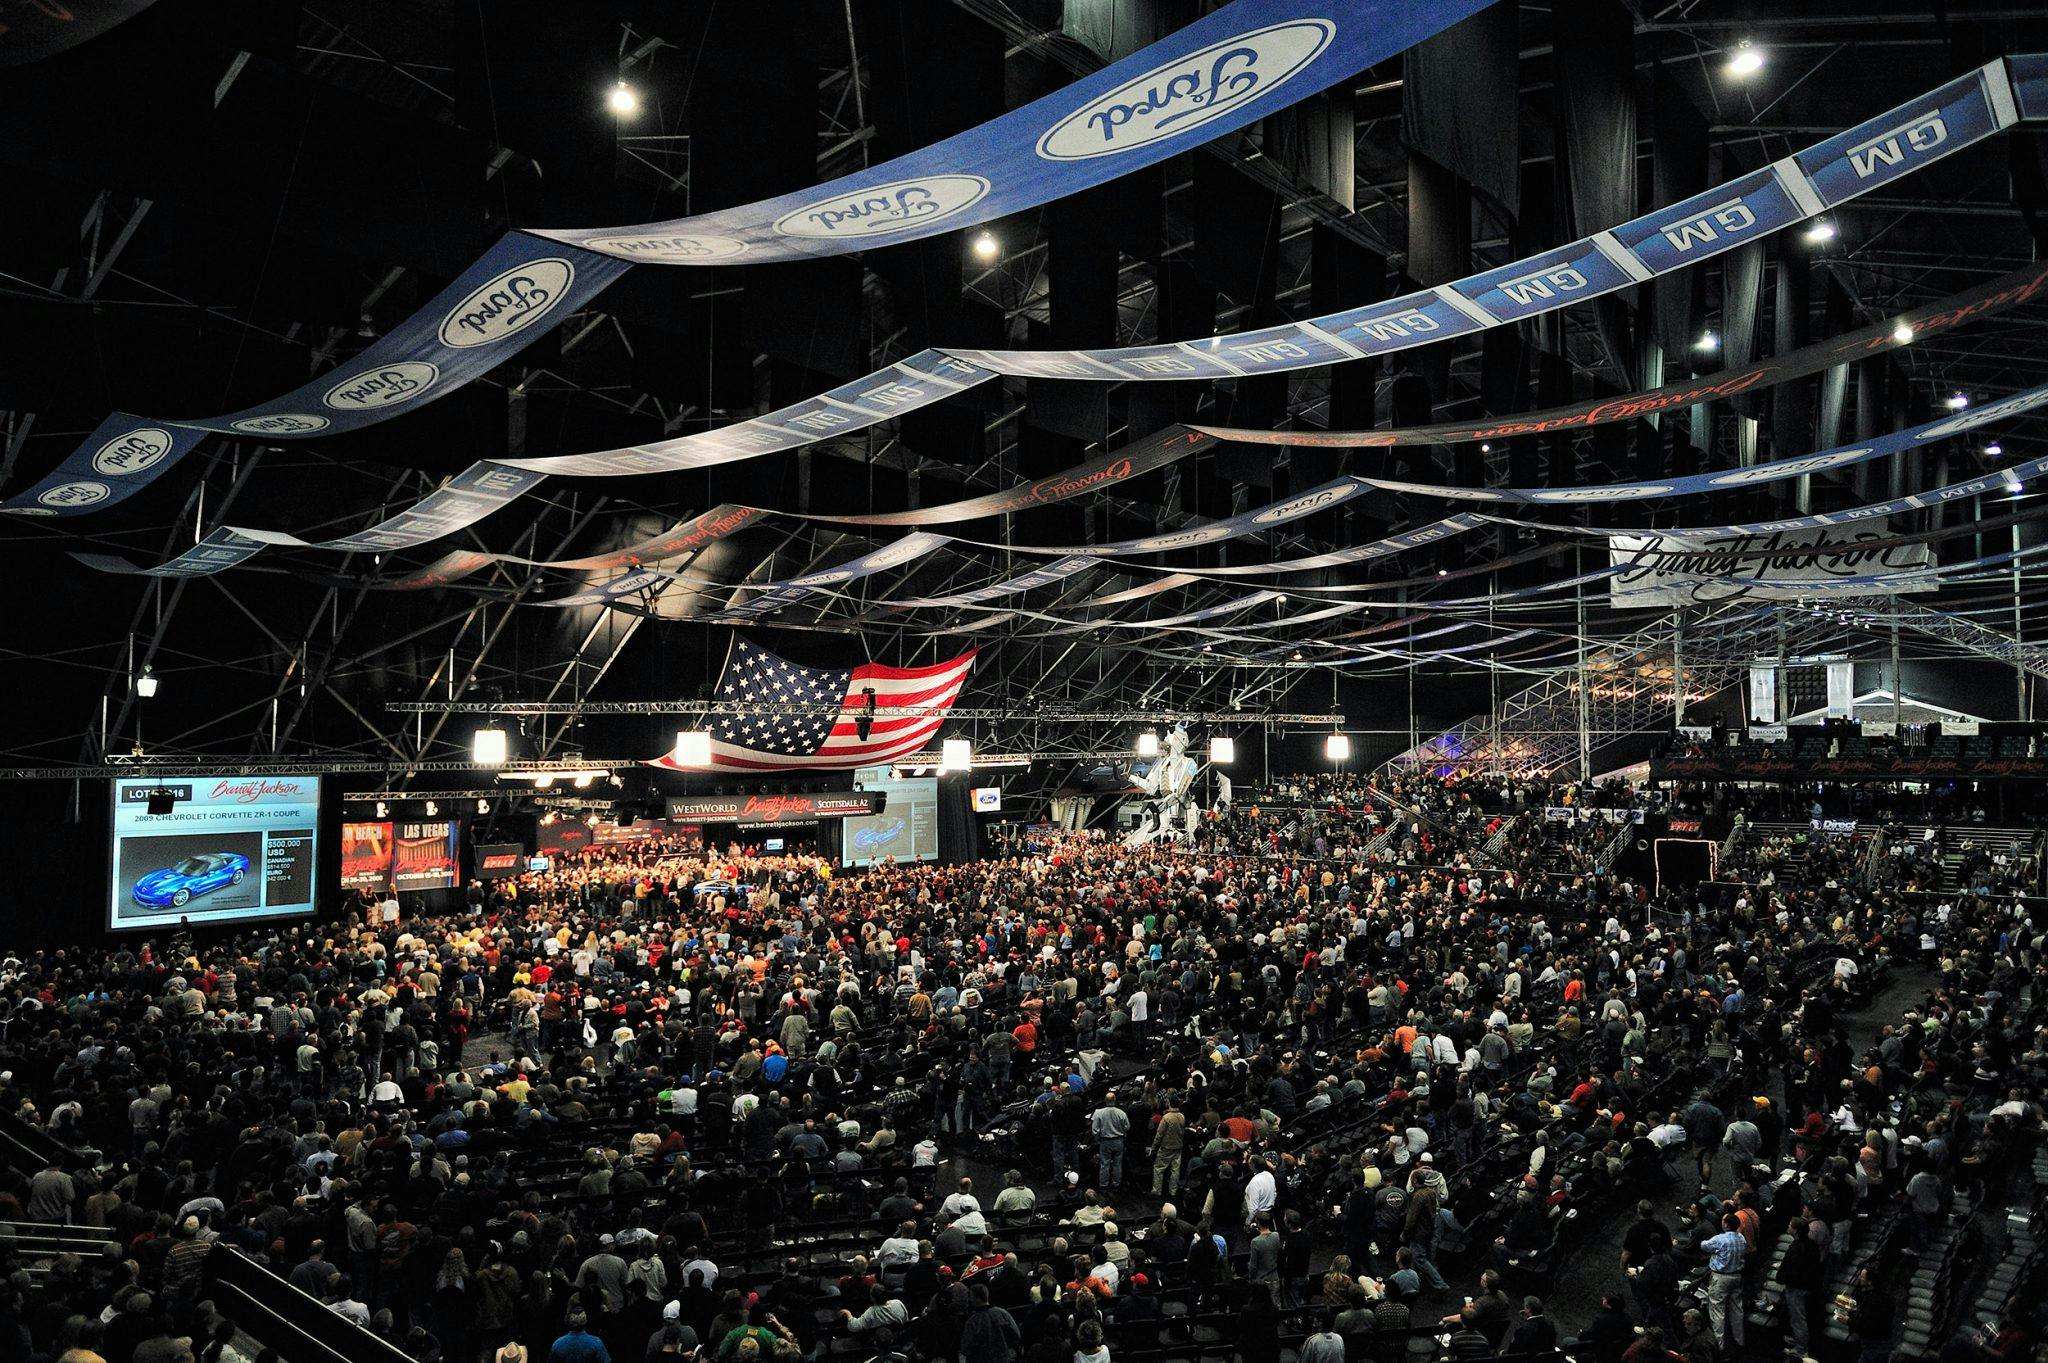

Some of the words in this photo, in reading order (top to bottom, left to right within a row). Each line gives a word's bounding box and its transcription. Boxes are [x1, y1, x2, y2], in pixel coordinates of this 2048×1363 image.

[1088, 47, 1259, 141] Ford
[1847, 109, 1947, 181] GM
[809, 187, 941, 231] Ford
[1664, 198, 1756, 253] GM
[608, 237, 715, 257] Ford
[1497, 262, 1588, 307] GM
[459, 276, 550, 335] Ford
[1355, 309, 1441, 343] GM
[1120, 356, 1196, 372] GM
[1229, 340, 1310, 364] GM
[340, 371, 419, 404] Ford
[859, 382, 925, 407] GM
[248, 417, 314, 432] Ford
[788, 410, 850, 430] GM
[103, 437, 161, 469] Ford
[1744, 455, 1836, 479] Ford
[472, 470, 523, 489] GM
[1941, 482, 1986, 499] GM
[50, 486, 100, 504] Ford
[1272, 491, 1333, 518] Ford
[1849, 506, 1893, 519] GM
[1617, 529, 1929, 601] Barrett-Jackson
[617, 575, 649, 591] Ford
[129, 790, 150, 799] LOT
[208, 780, 304, 803] Barrett-Jackson
[156, 814, 207, 822] CHEVROLET
[210, 812, 252, 820] CORVETTE
[273, 810, 300, 818] COUPE
[740, 795, 815, 822] Barrett-Jackson
[860, 798, 868, 807] AZ
[355, 825, 382, 840] BEACH
[404, 825, 420, 839] LAS
[422, 824, 449, 838] VEGAS
